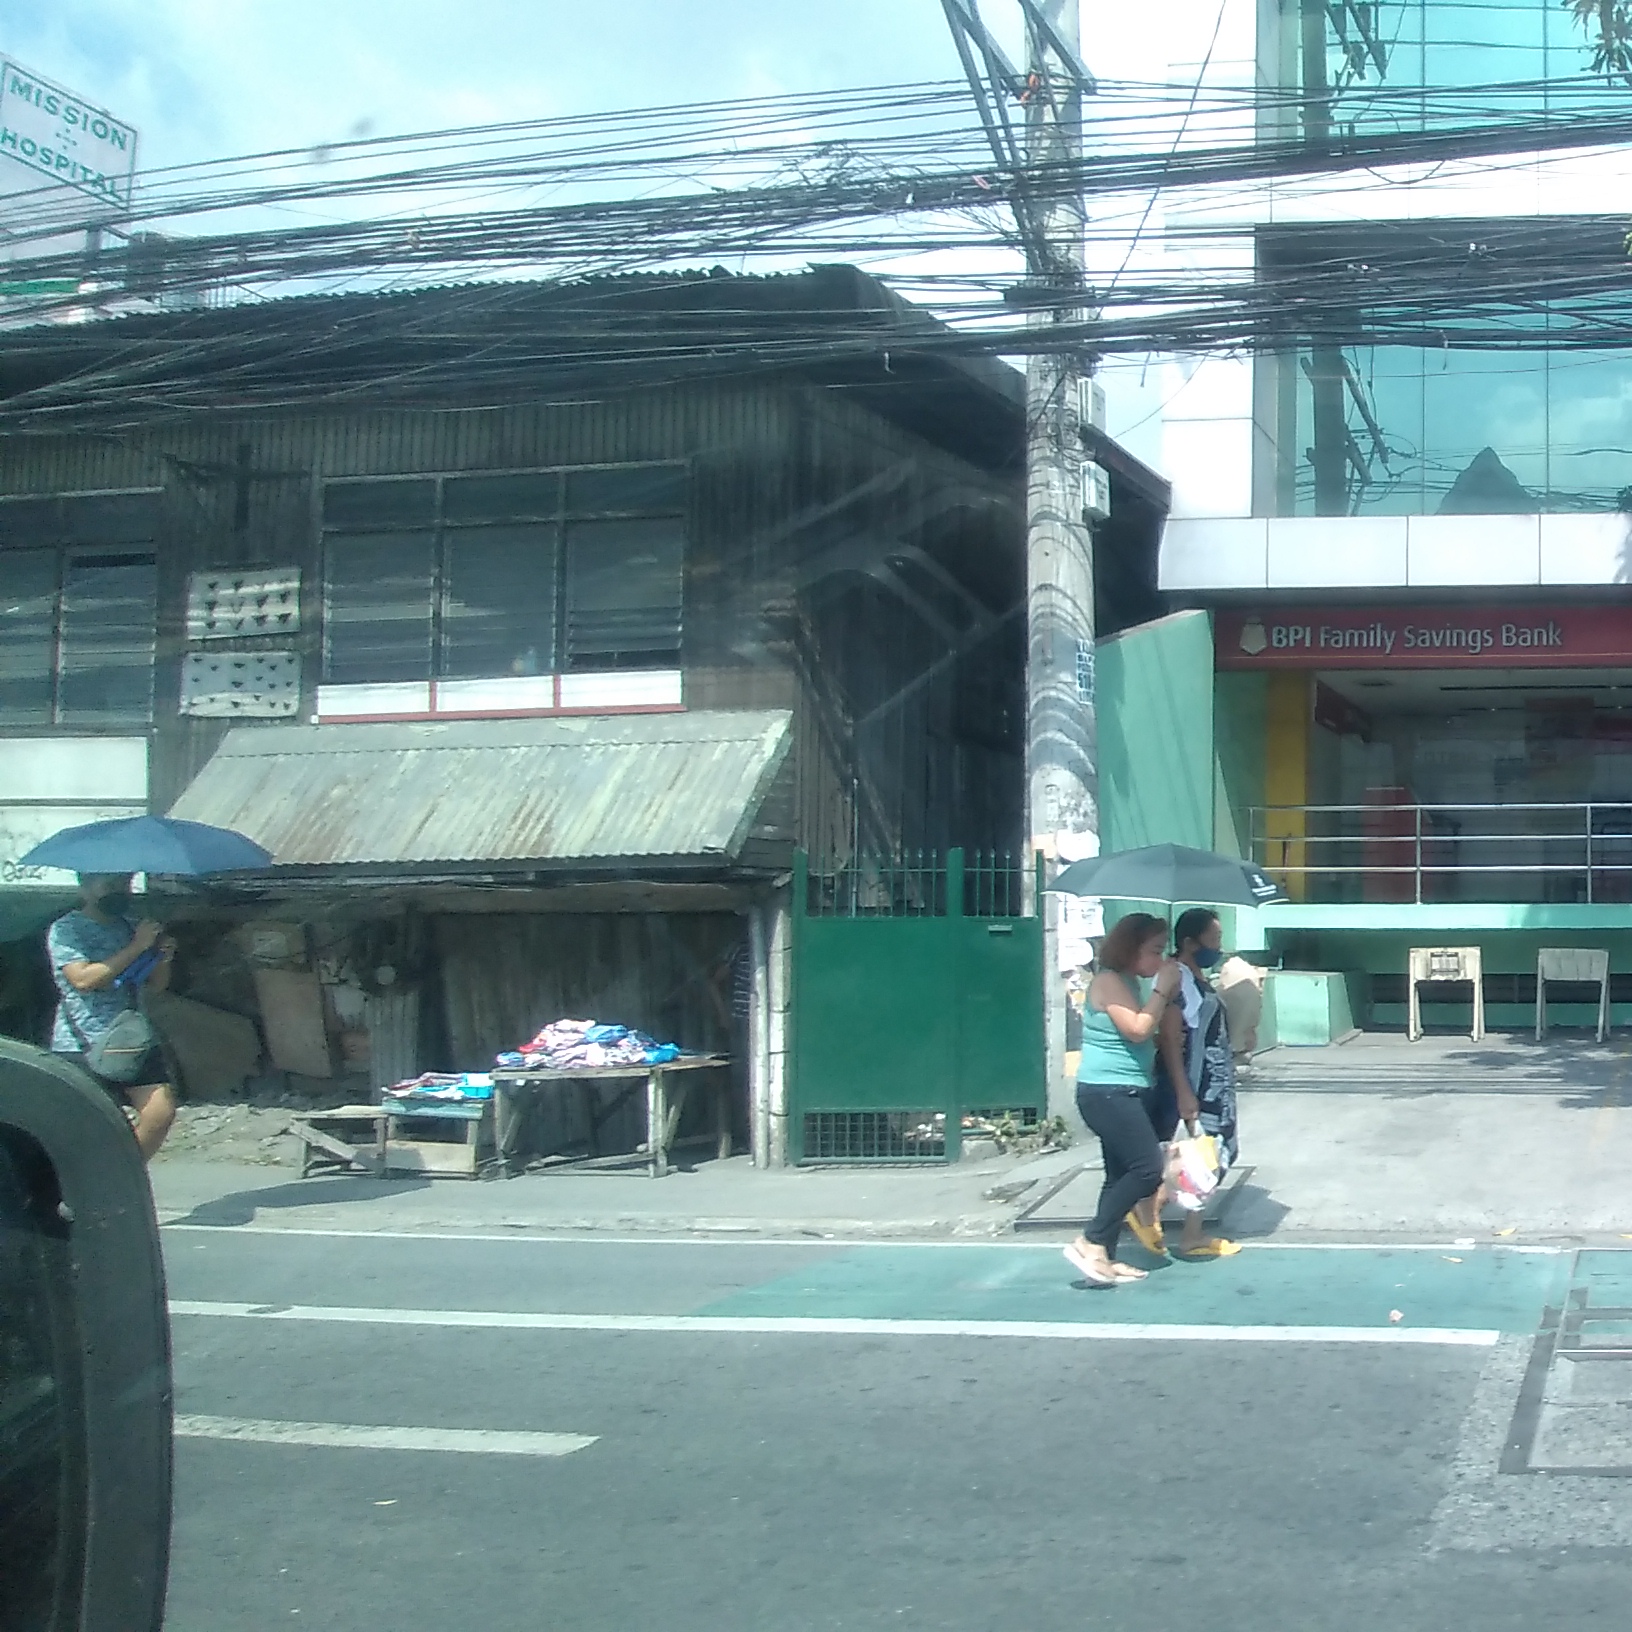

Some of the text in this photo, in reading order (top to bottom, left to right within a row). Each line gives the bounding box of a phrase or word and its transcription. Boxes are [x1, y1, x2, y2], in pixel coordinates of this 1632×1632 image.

[10, 76, 127, 150] MISSION
[1, 126, 124, 201] HOSPITAL
[1271, 621, 1563, 654] BPI Family Savings Bank
